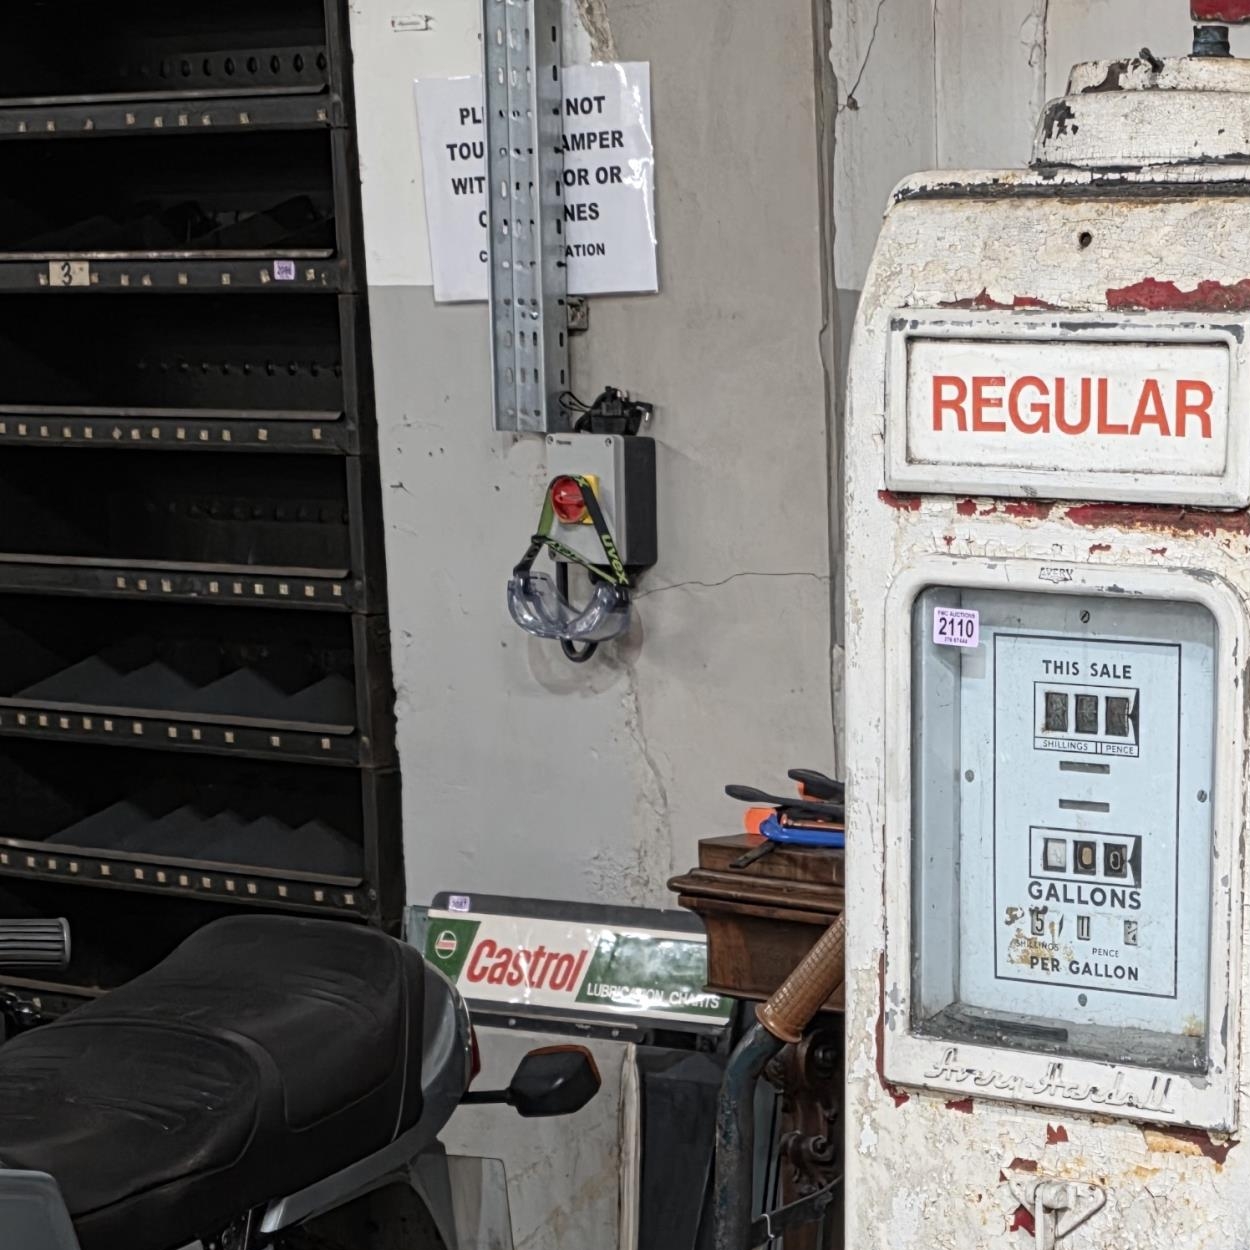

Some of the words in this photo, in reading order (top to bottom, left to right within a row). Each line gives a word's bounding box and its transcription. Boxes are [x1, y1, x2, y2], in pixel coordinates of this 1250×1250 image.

[566, 96, 606, 116] NOT
[595, 166, 622, 185] OR
[61, 261, 73, 286] 3
[932, 375, 1214, 439] REGULAR
[938, 617, 974, 638] 2110
[1042, 659, 1080, 676] THIS
[1090, 662, 1132, 680] SALE
[1042, 740, 1088, 751] SHILLINGS
[1105, 744, 1134, 755] PENCE
[1028, 880, 1142, 911] GALLONS
[1092, 947, 1120, 959] PENCE
[467, 939, 589, 992] Castrol
[1030, 956, 1061, 973] PER
[1068, 960, 1139, 981] GALLON
